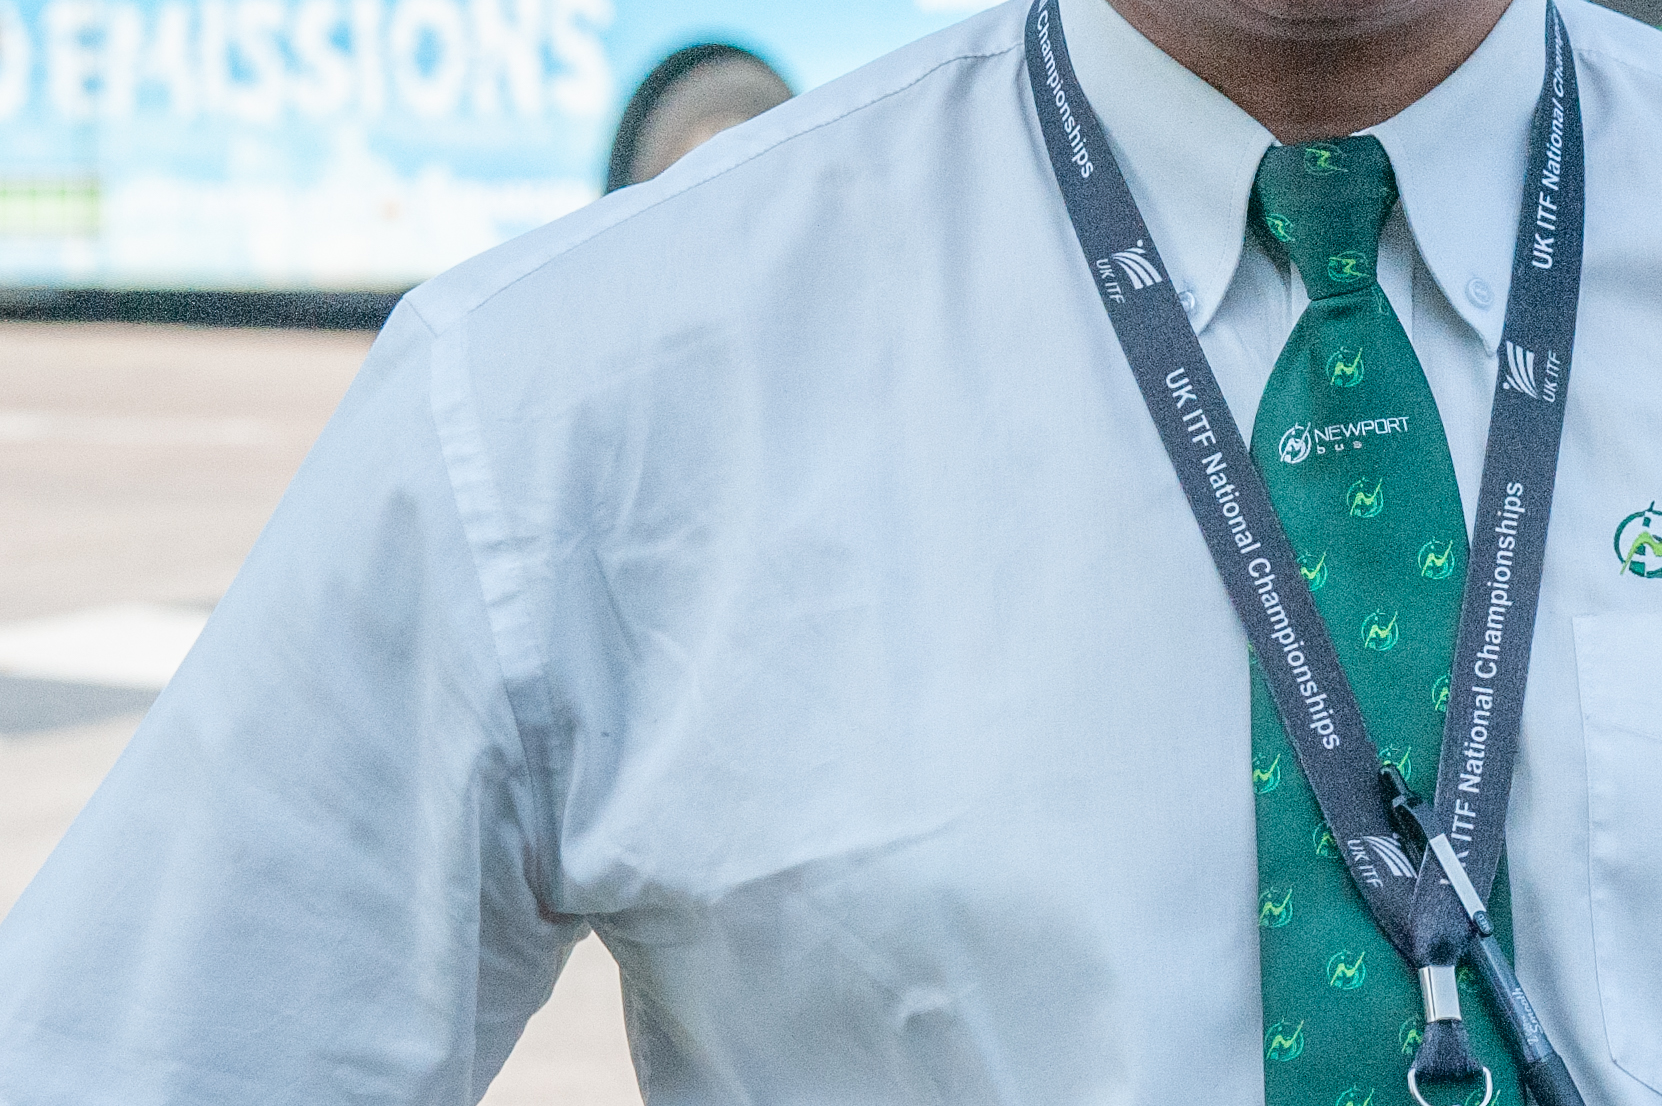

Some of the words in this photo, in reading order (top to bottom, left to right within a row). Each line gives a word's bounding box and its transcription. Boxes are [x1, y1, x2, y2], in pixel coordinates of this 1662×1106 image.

[1036, 10, 1095, 179] Championships
[1541, 97, 1565, 191] National
[1536, 191, 1558, 231] ITF
[1096, 258, 1116, 279] UK
[1532, 231, 1554, 270] UK
[1104, 281, 1126, 305] ITF
[1546, 349, 1561, 378] ITF
[1542, 377, 1558, 403] UK
[1313, 416, 1410, 444] NEWPORT
[1165, 367, 1199, 410] UK
[1182, 409, 1218, 447] ITF
[1201, 451, 1262, 555] National
[1248, 557, 1341, 751] Championships
[1474, 480, 1526, 681] Championships
[1459, 685, 1495, 794] National
[1450, 798, 1477, 842] ITF
[1347, 839, 1372, 862] UK
